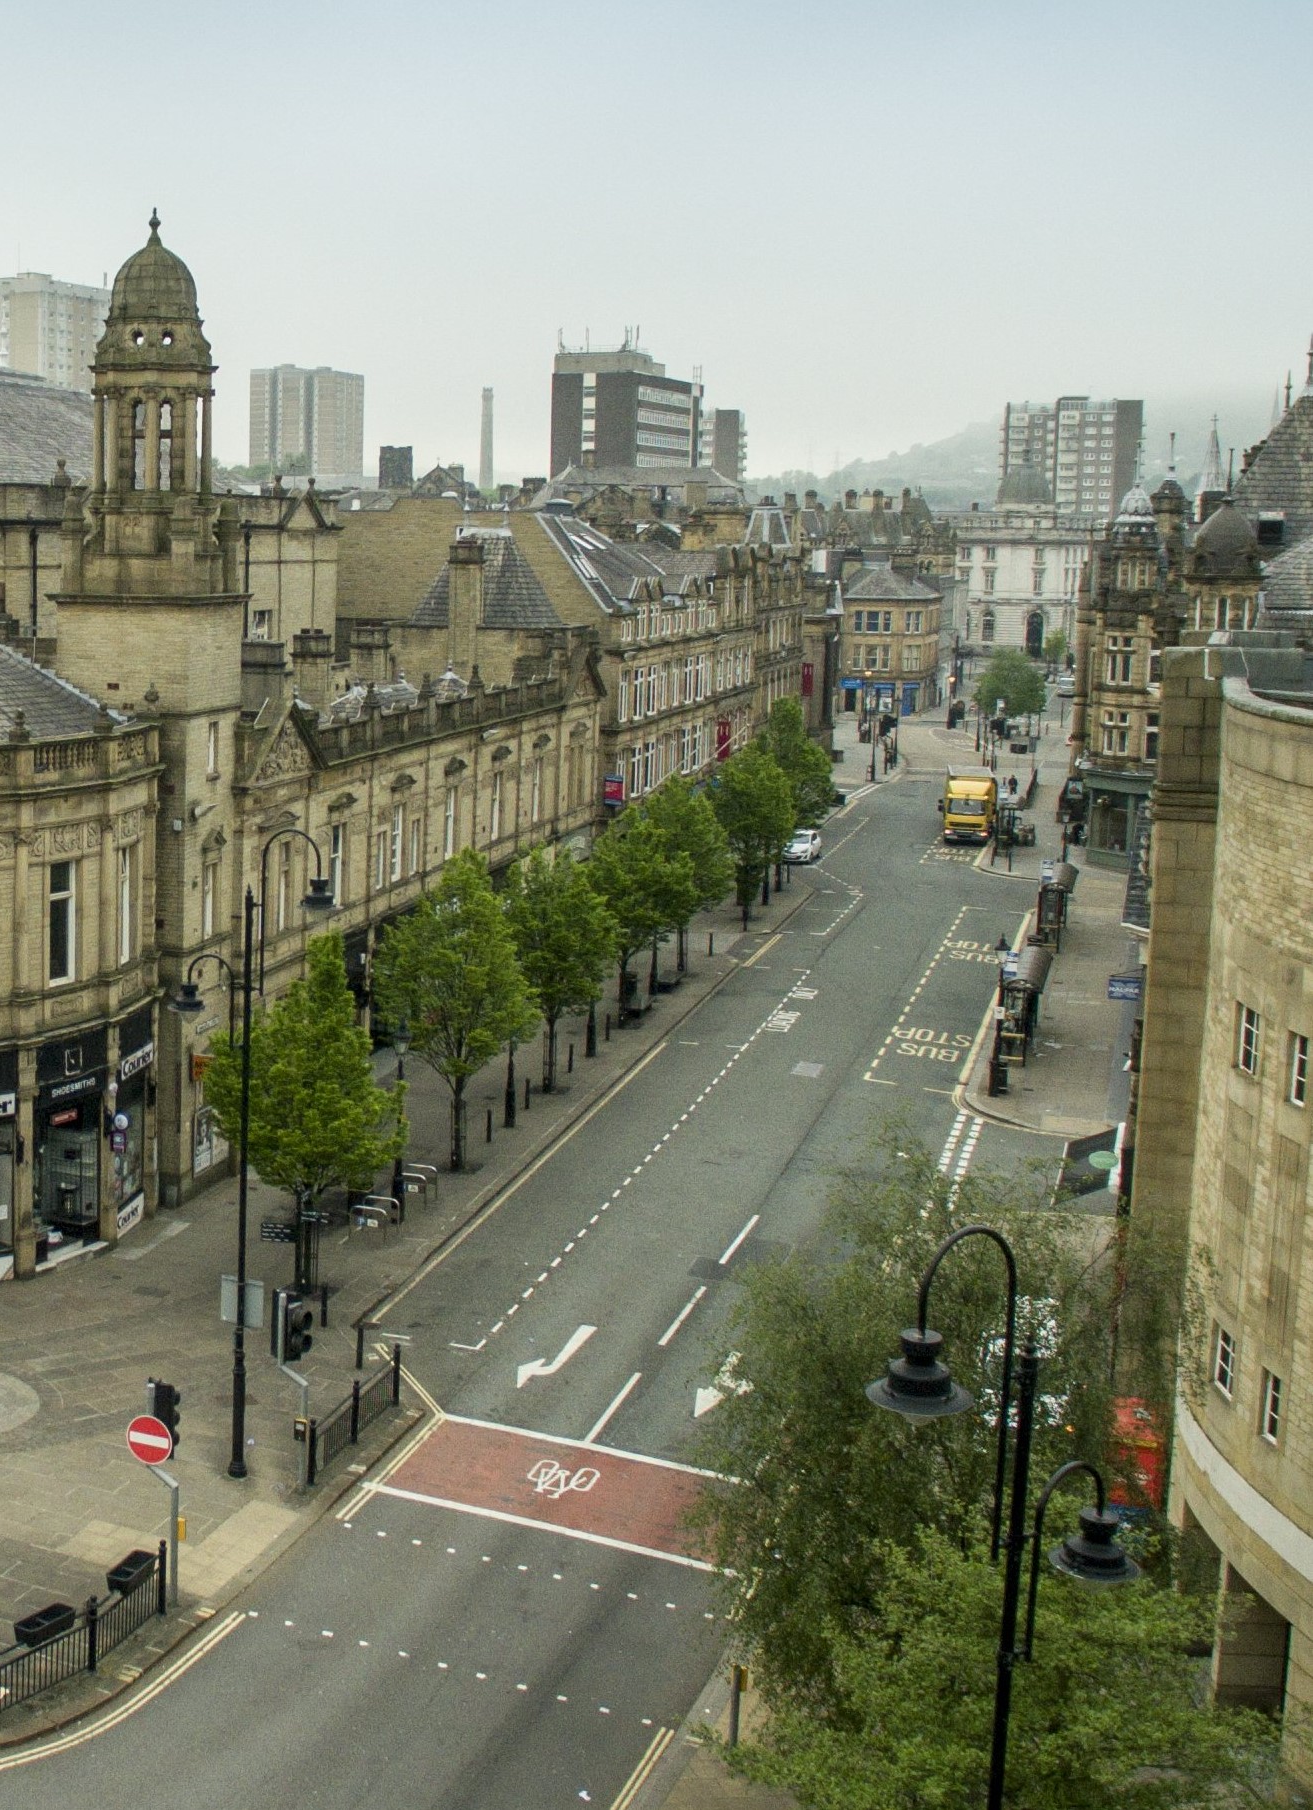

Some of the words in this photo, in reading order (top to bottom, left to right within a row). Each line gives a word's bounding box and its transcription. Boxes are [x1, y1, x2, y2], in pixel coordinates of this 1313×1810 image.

[946, 940, 991, 951] TOP
[894, 1027, 972, 1047] STOP
[897, 1043, 960, 1062] BUS
[123, 1049, 152, 1077] Courier
